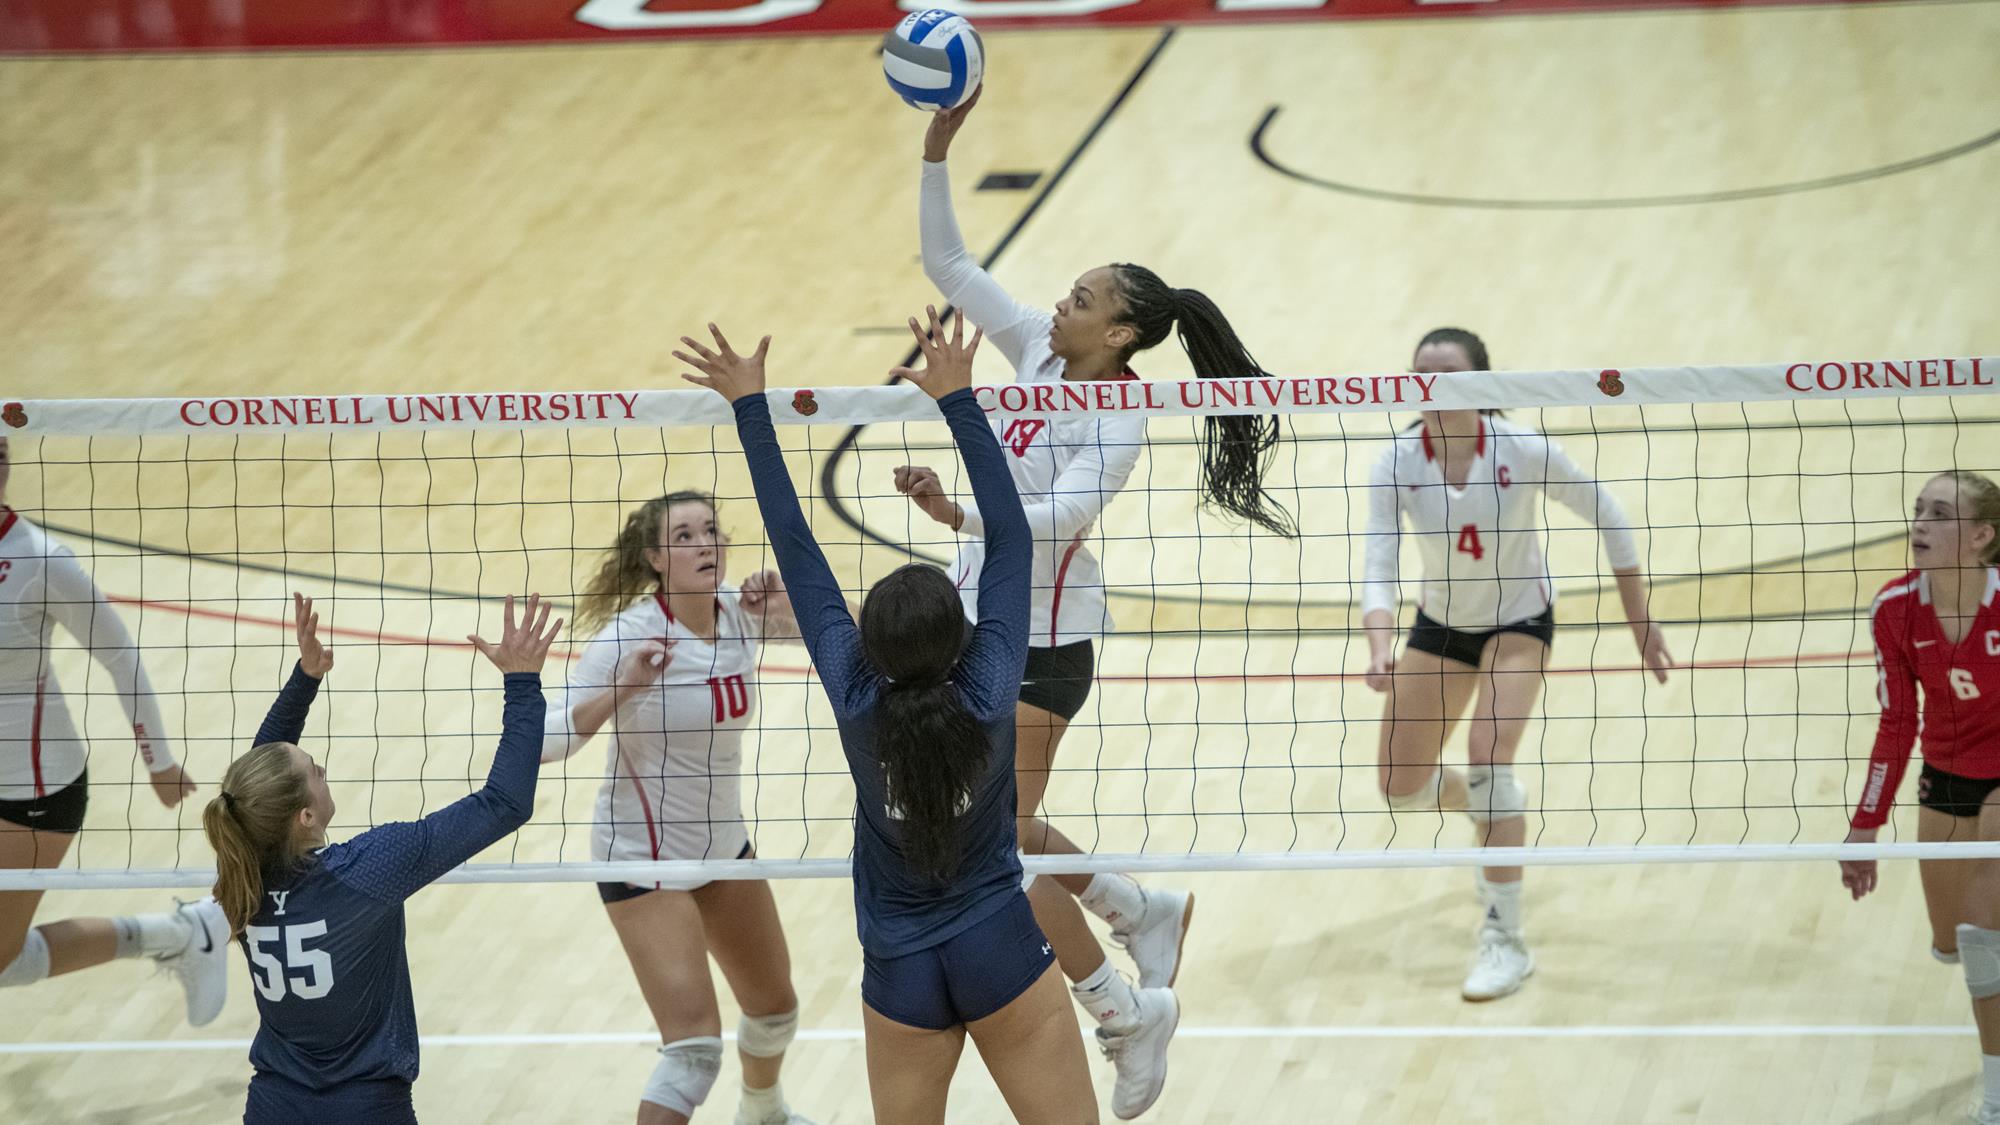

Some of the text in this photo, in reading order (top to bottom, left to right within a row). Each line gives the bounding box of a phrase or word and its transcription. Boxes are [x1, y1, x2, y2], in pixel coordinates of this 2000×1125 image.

[1785, 358, 1993, 392] CORNELL
[180, 392, 639, 427] CORNELL UNIVERSITY
[972, 375, 1437, 412] CORNELL UNIVERSITY
[1497, 464, 1511, 488] C
[1457, 523, 1484, 561] 4
[706, 673, 748, 723] 10
[1946, 667, 1981, 700] 6
[268, 890, 290, 916] Y
[246, 918, 335, 1002] 55
